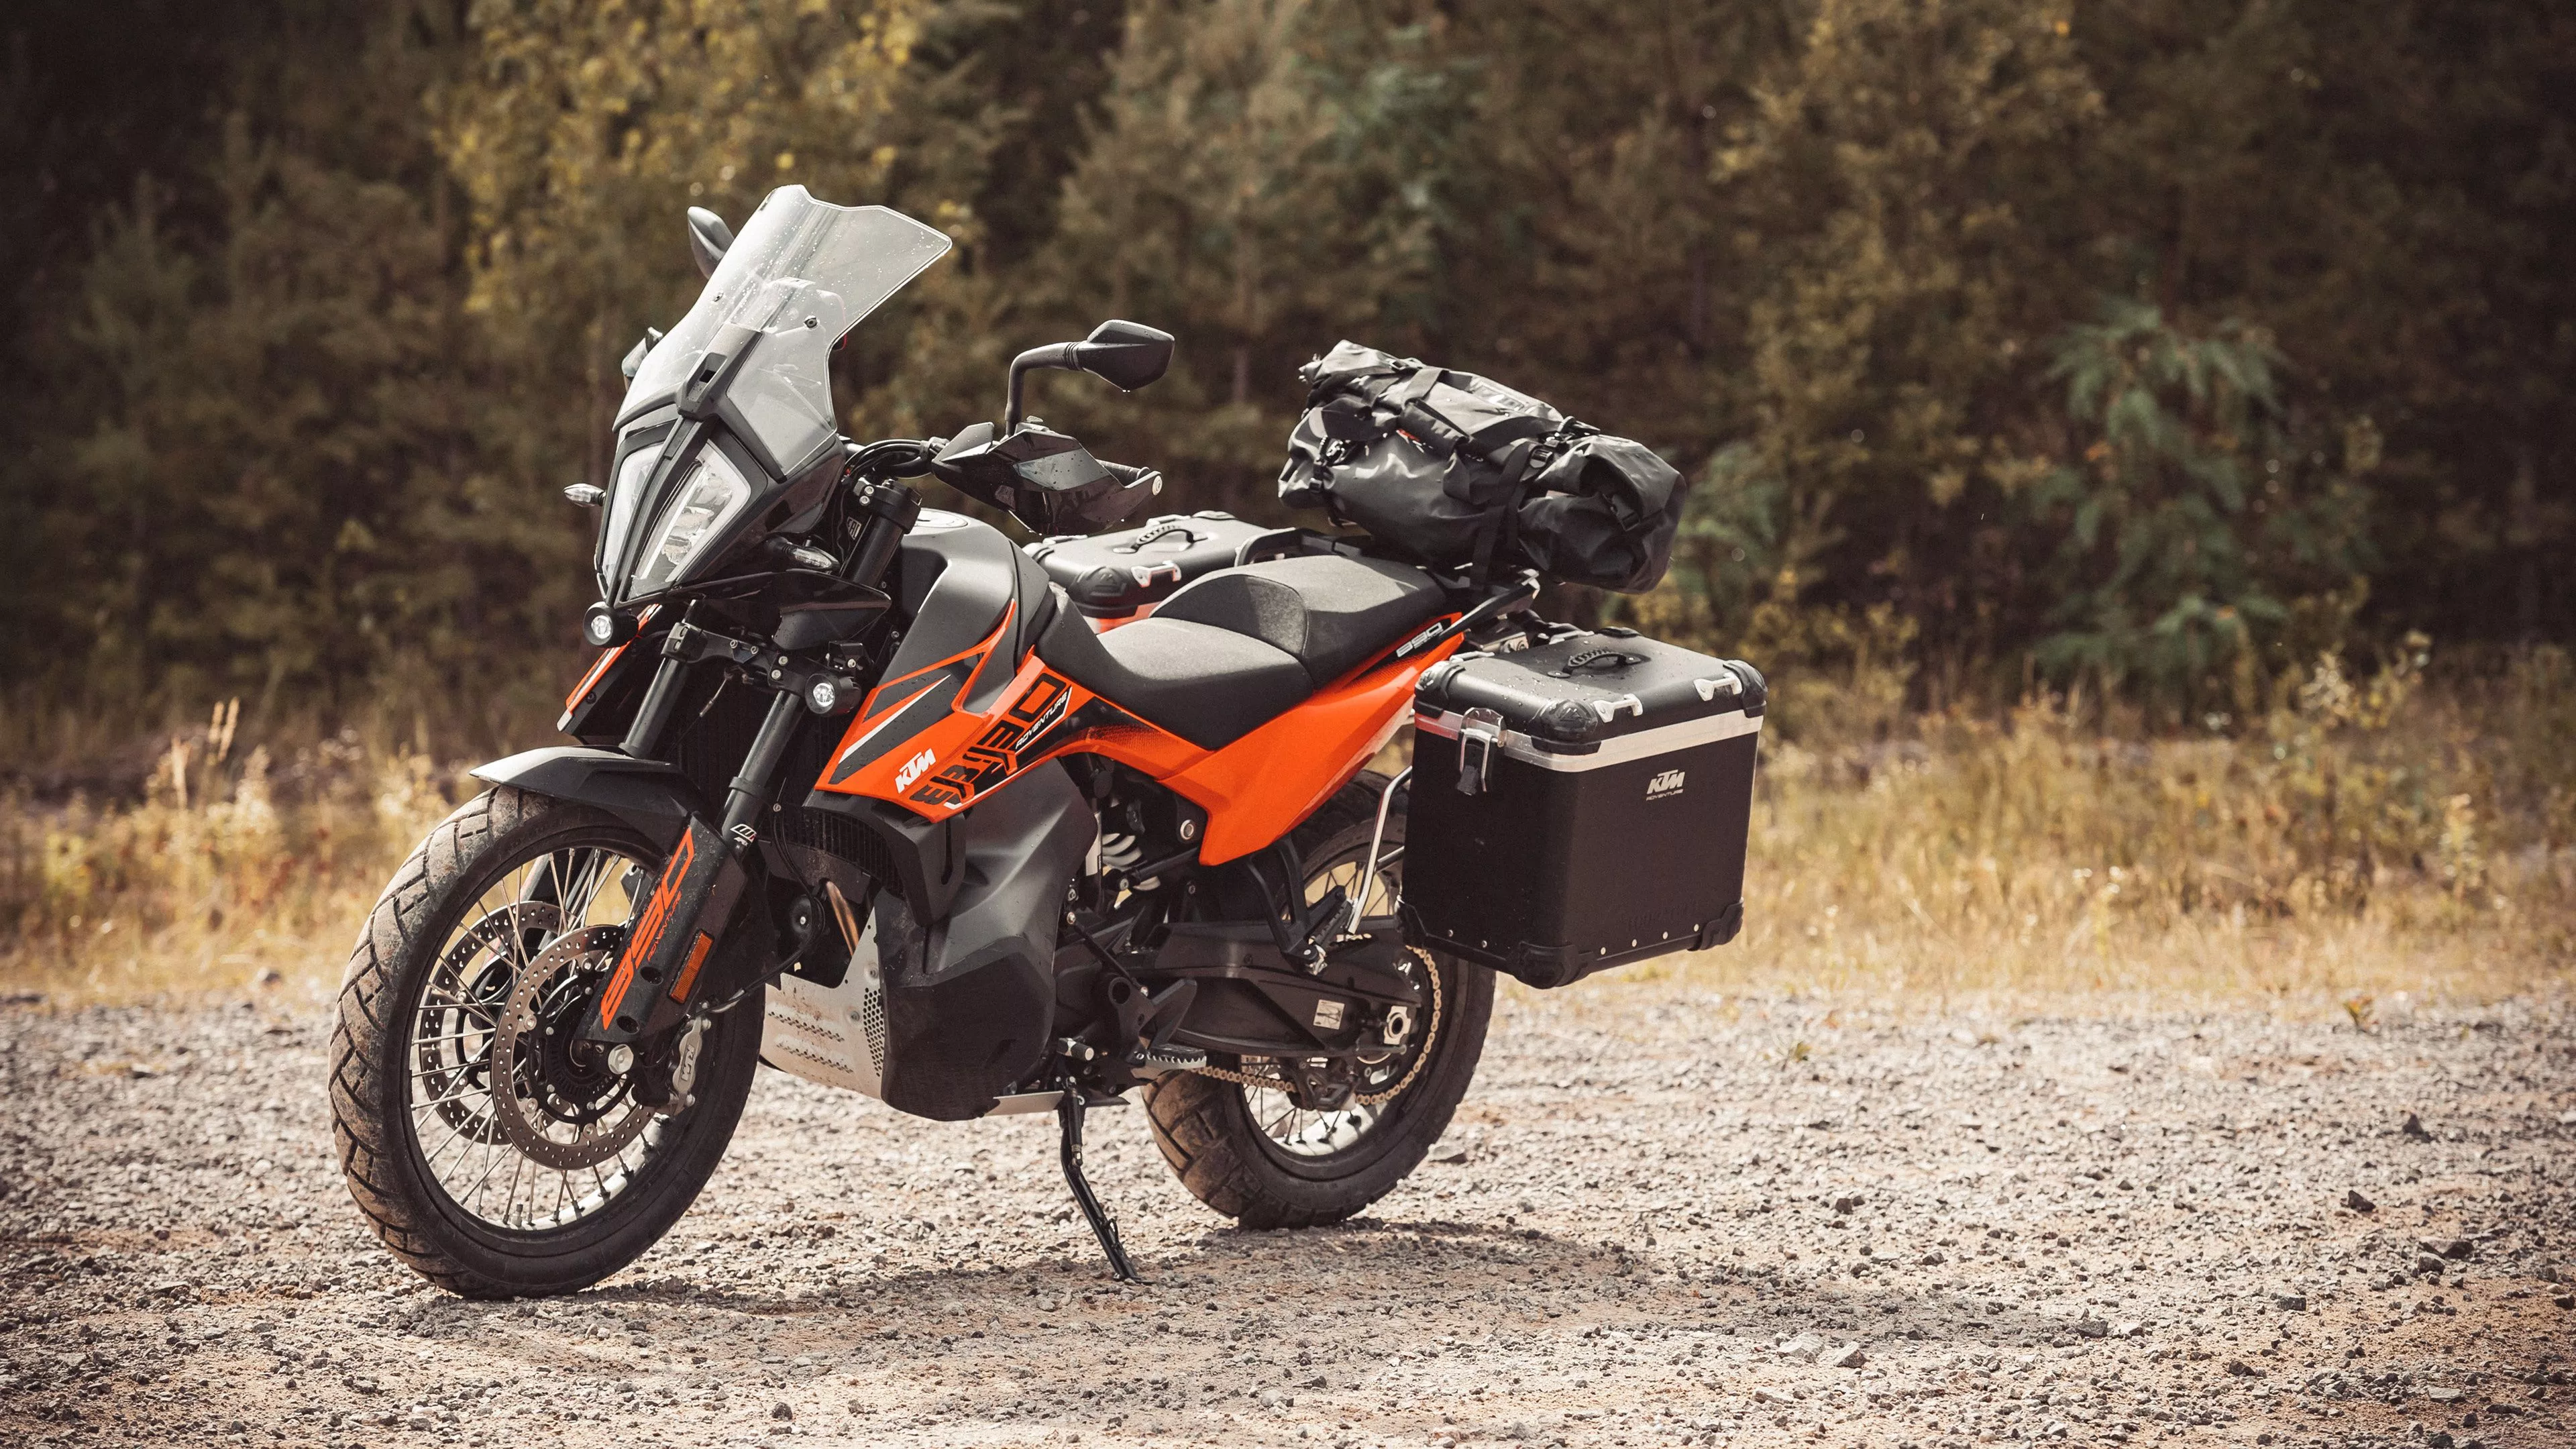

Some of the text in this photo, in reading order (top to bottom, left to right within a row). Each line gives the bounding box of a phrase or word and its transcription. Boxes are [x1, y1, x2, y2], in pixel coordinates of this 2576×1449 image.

[1396, 623, 1443, 657] 890
[1016, 692, 1068, 749] ADVENTURE
[895, 748, 936, 794] KTM
[1647, 769, 1685, 794] KTM
[601, 826, 694, 1030] 890
[648, 891, 682, 961] ADVENTURE
[682, 1044, 695, 1082] KTM
